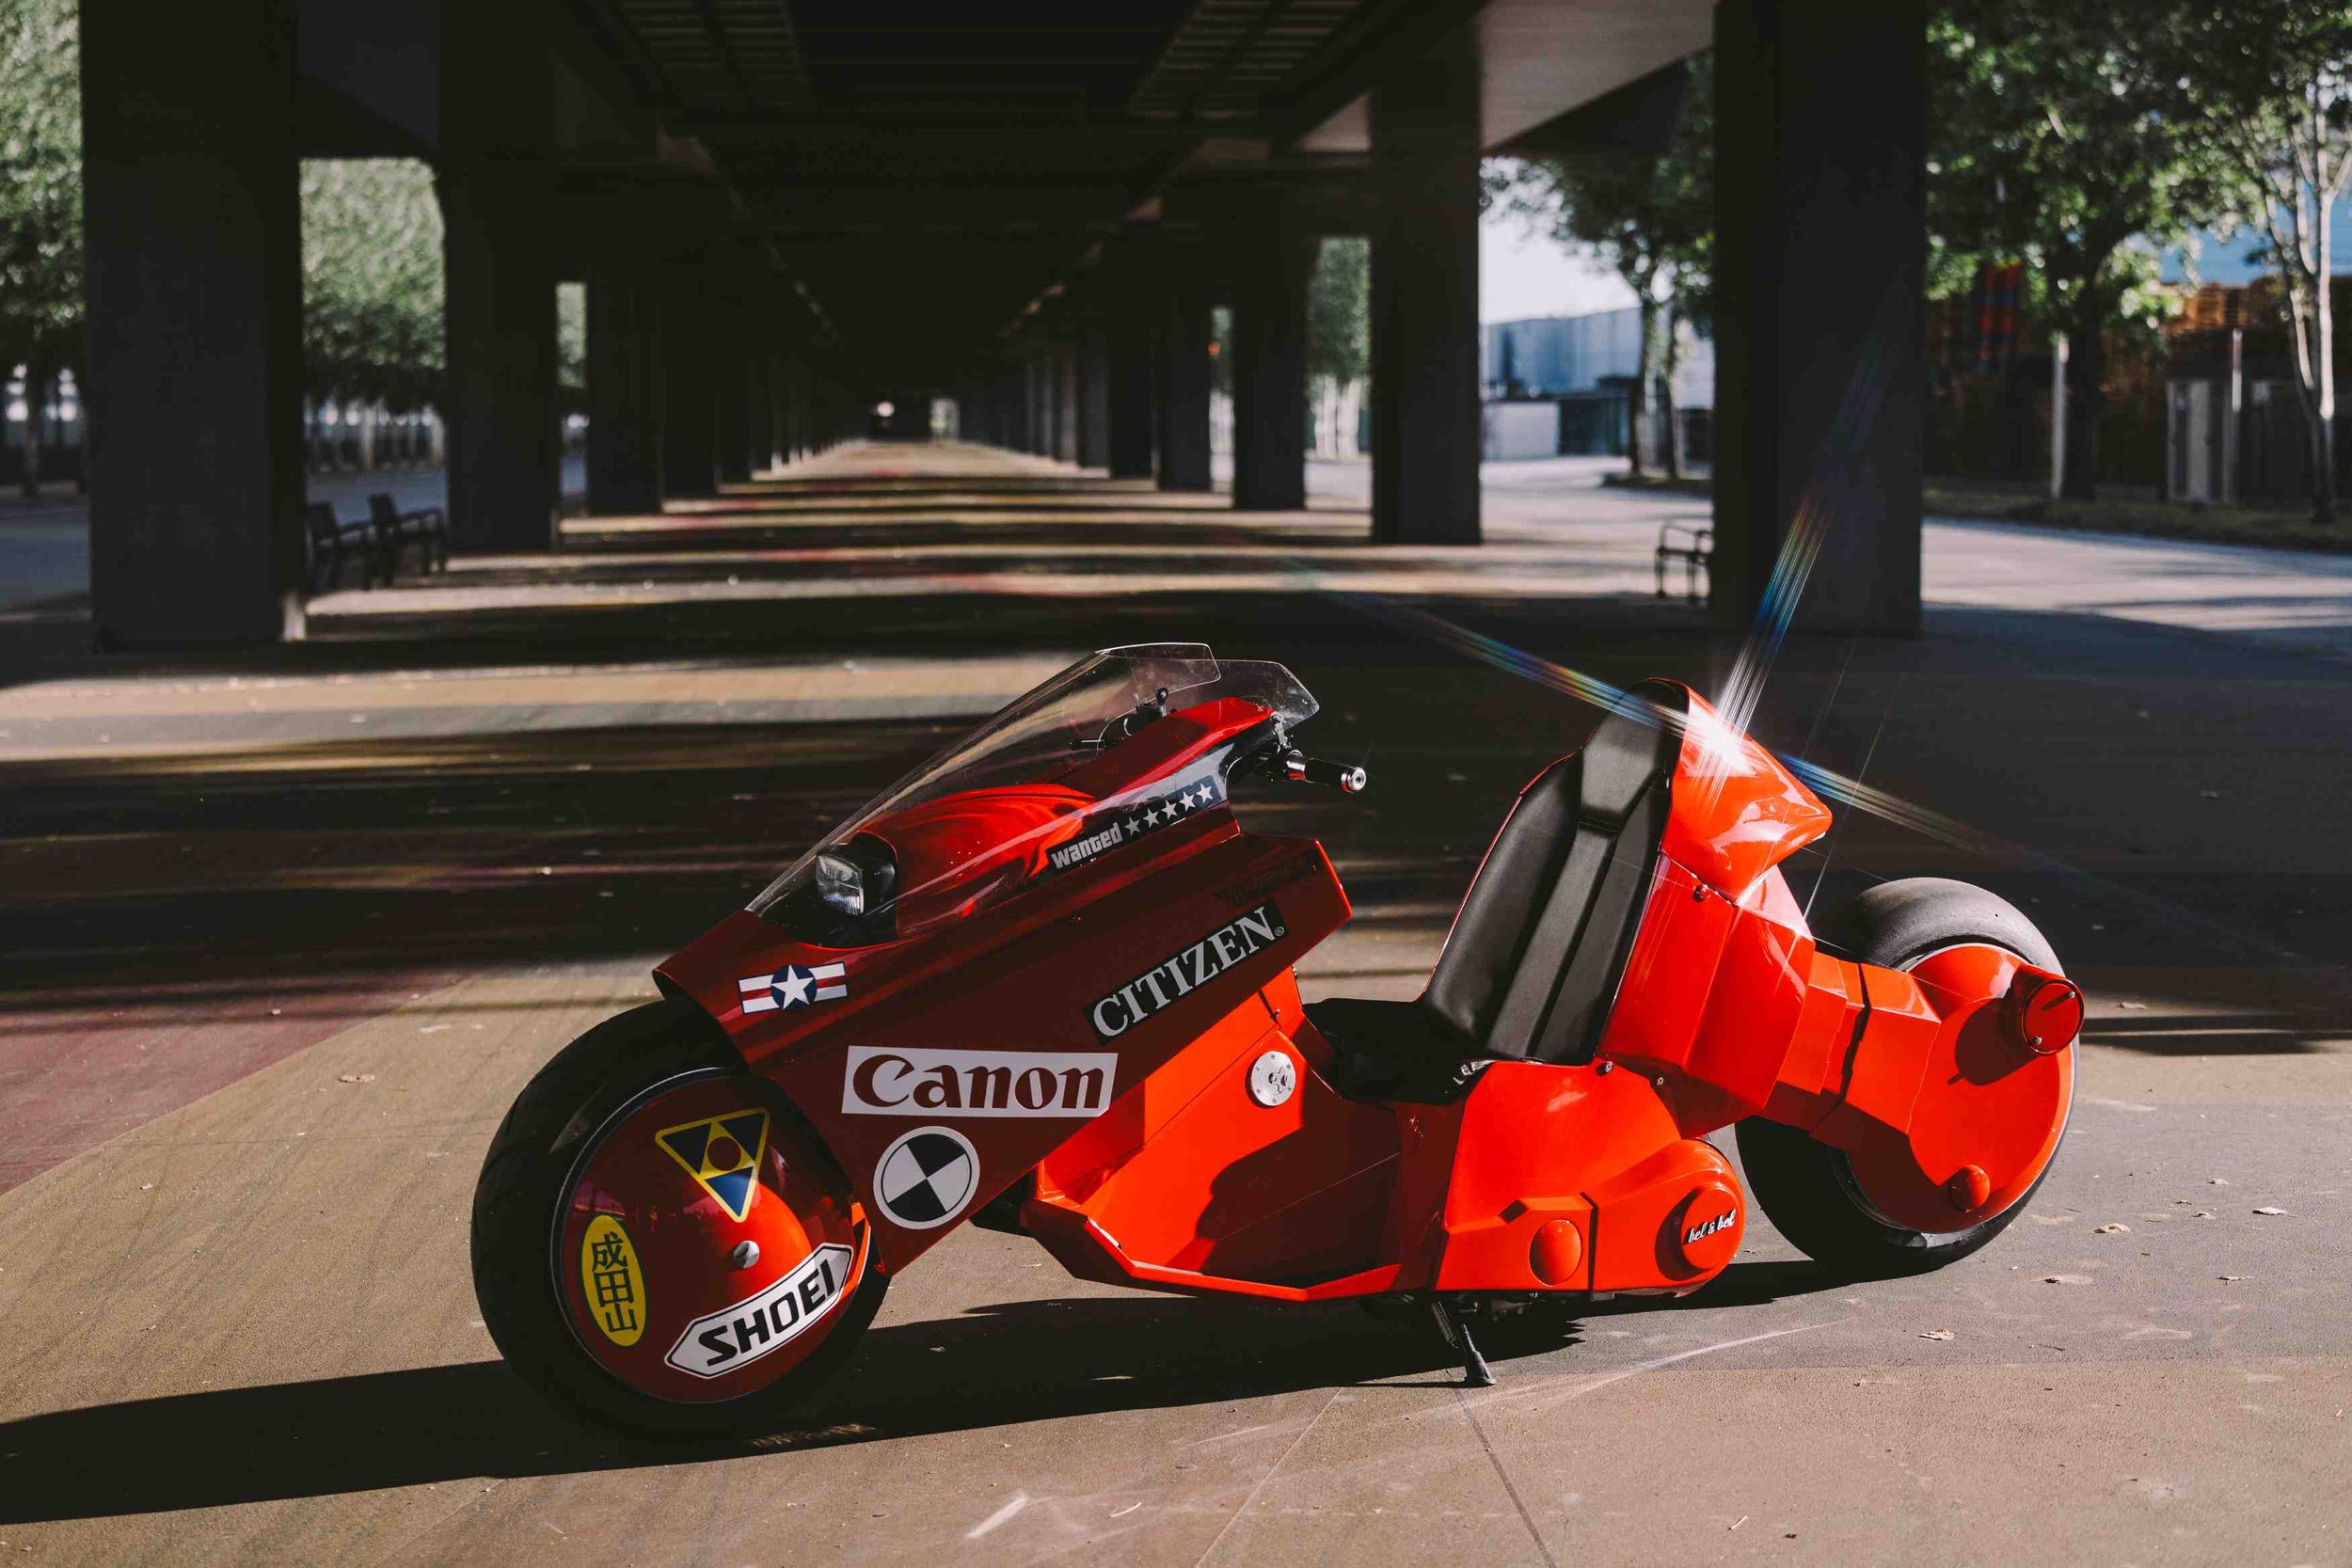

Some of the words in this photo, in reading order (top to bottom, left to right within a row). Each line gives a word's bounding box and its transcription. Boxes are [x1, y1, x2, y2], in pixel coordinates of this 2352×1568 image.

[852, 1054, 1104, 1110] Canon
[1688, 1221, 1708, 1243] bel
[1708, 1221, 1716, 1235] &
[1716, 1209, 1737, 1230] bel
[591, 1231, 638, 1332] 成田山
[698, 1259, 835, 1367] SHOEI
